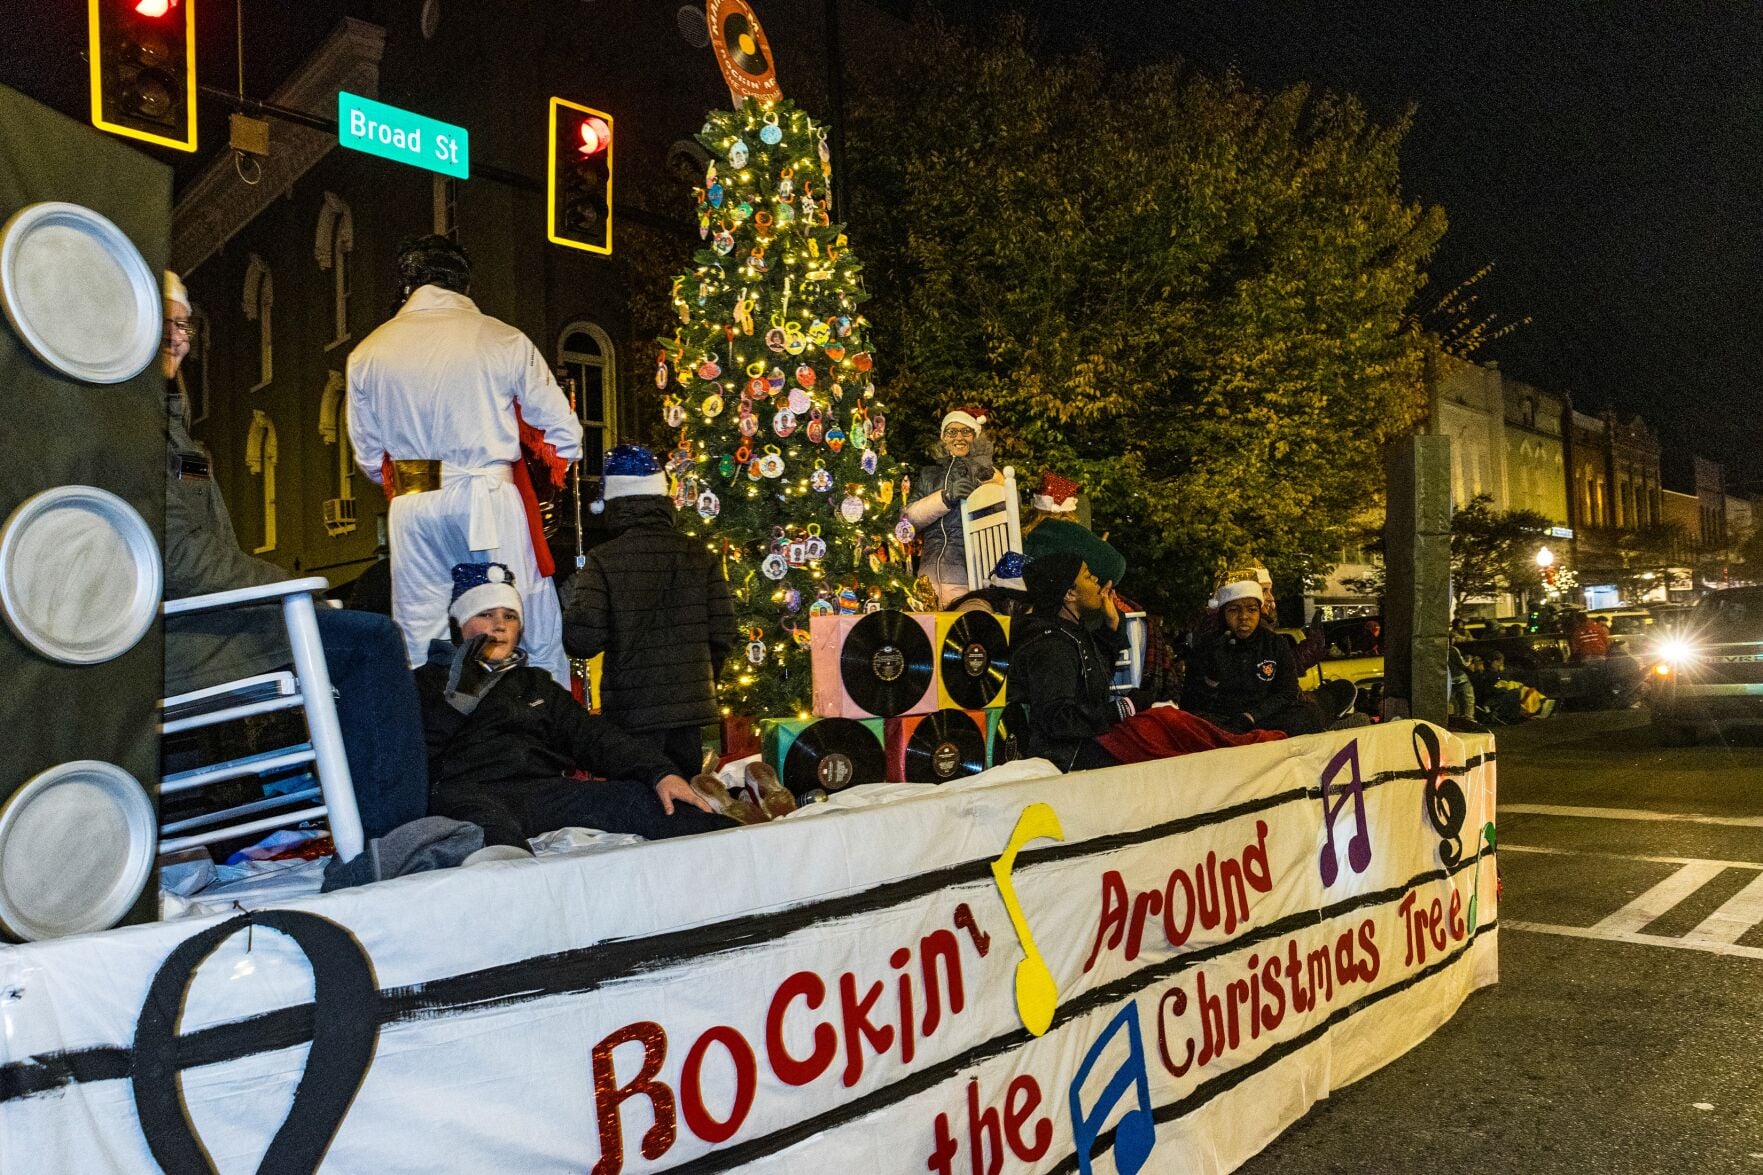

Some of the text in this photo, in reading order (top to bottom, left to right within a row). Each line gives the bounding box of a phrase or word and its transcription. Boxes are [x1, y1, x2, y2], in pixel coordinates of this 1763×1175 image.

[350, 108, 459, 164] Broad St
[927, 887, 1465, 1175] the Christmas Tree
